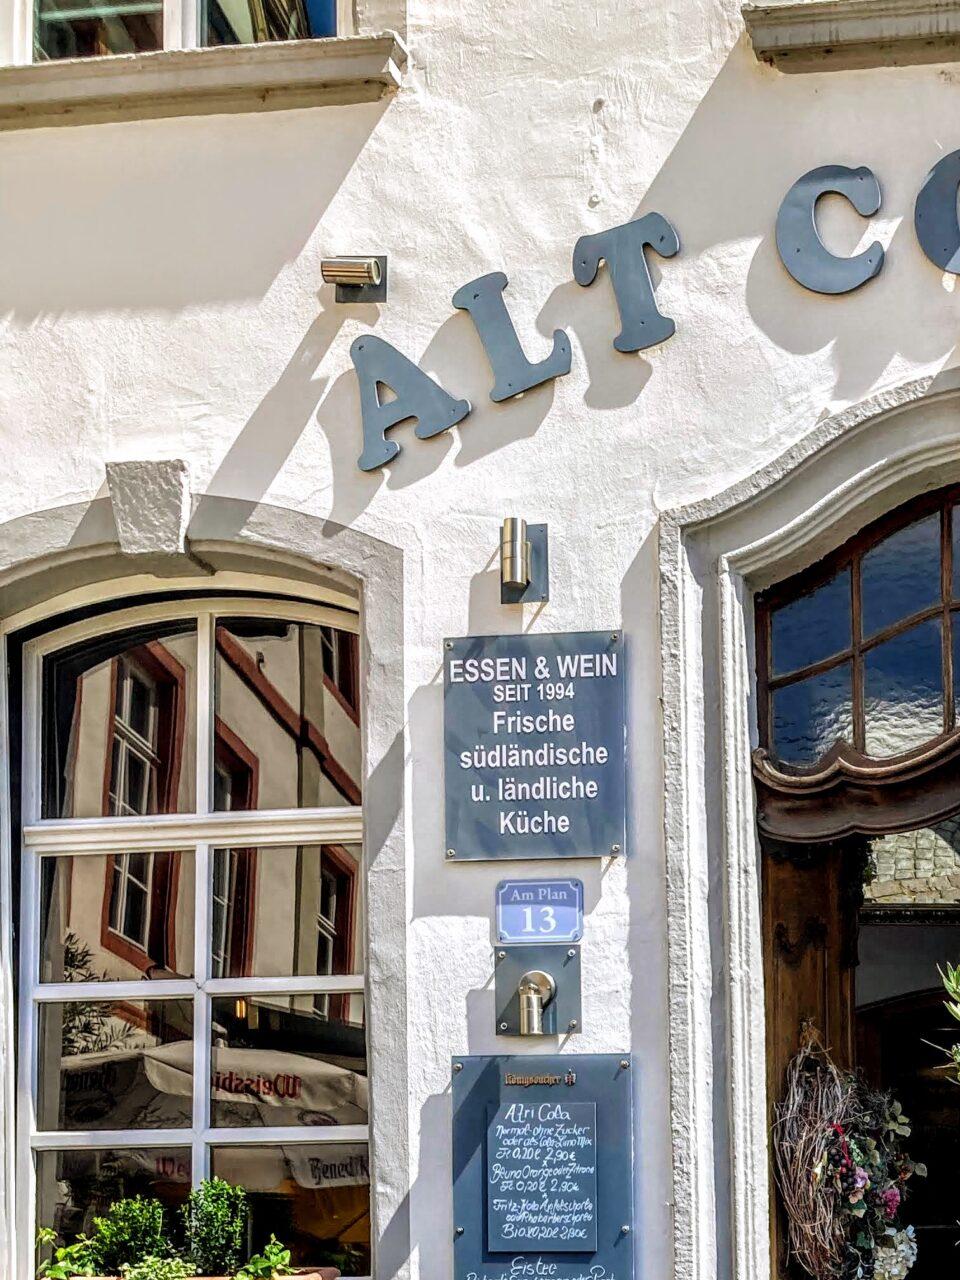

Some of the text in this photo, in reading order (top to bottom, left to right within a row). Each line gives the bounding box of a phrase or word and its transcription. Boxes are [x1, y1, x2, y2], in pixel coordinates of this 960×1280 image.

[350, 211, 680, 472] ALT
[449, 653, 618, 683] ESSEN & WEIN
[493, 682, 575, 702] SEIT 1994
[493, 709, 575, 734] Frische
[460, 742, 608, 769] südländische
[471, 776, 598, 802] u. ländliche
[500, 811, 570, 835] Küche
[511, 887, 567, 901] Am Plan
[521, 905, 556, 933] 13
[538, 1103, 571, 1122] Cola
[502, 1136, 524, 1146] oder
[554, 1123, 590, 1138] Zucker
